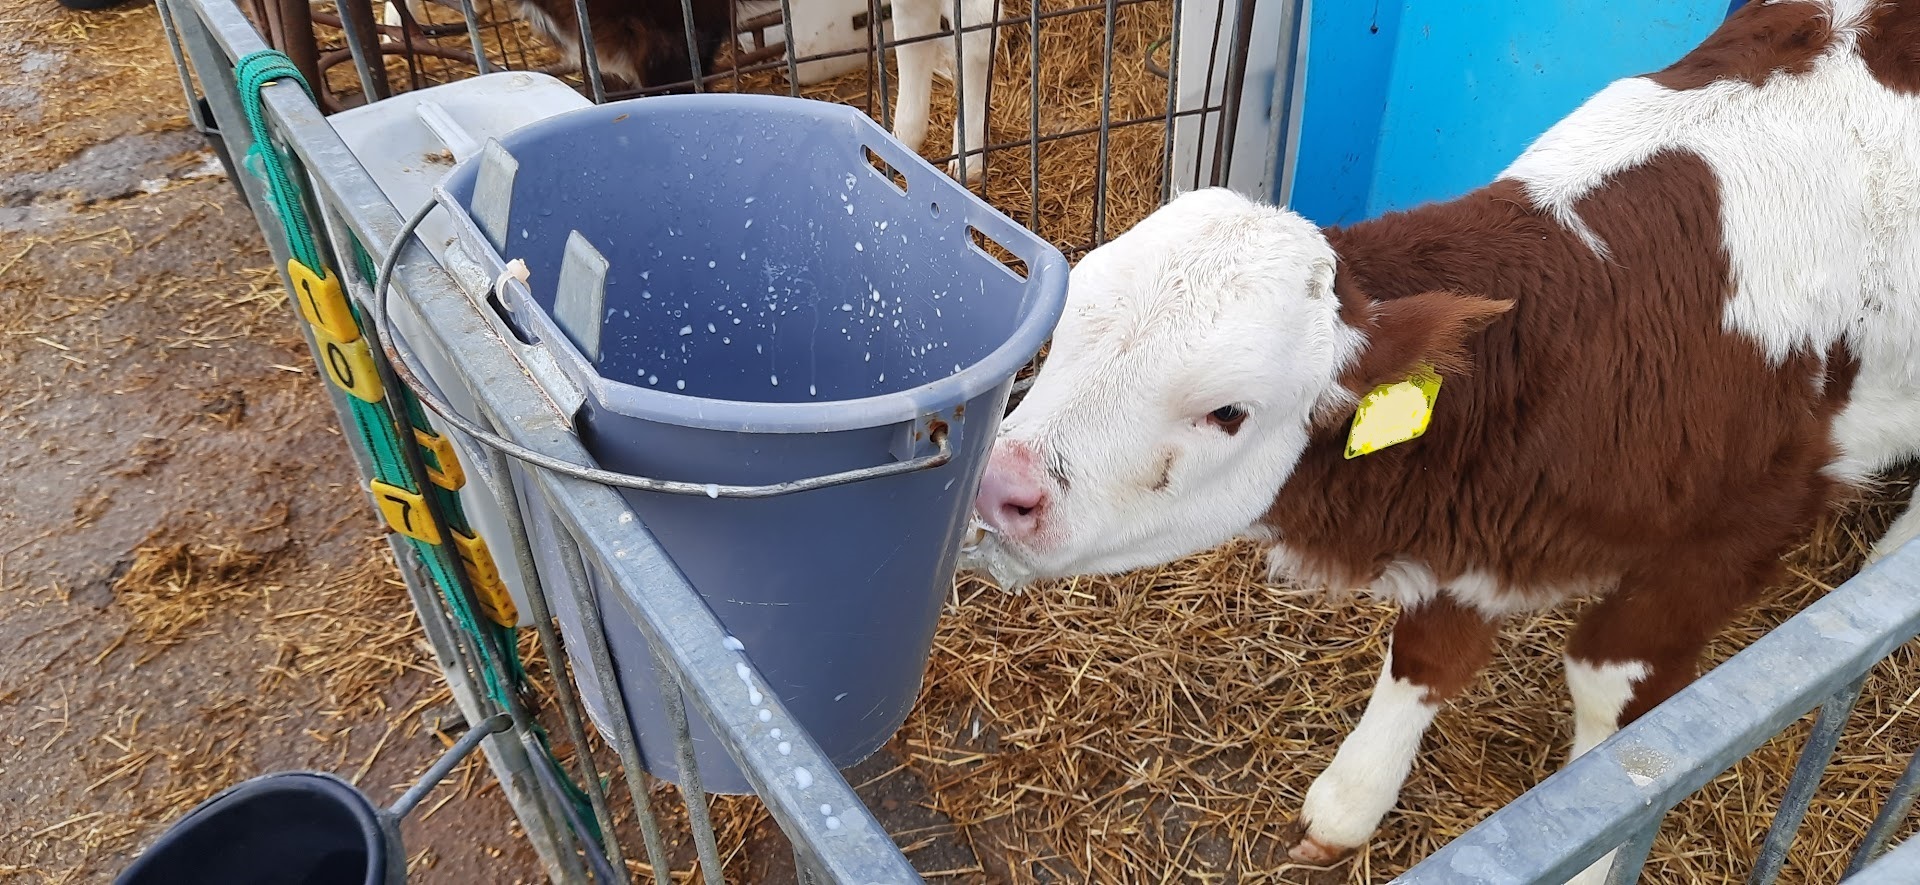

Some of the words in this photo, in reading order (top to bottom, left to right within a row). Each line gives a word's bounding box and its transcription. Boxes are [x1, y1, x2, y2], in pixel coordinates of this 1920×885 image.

[301, 278, 325, 325] 1
[327, 342, 355, 389] 0
[383, 493, 414, 533] 7
